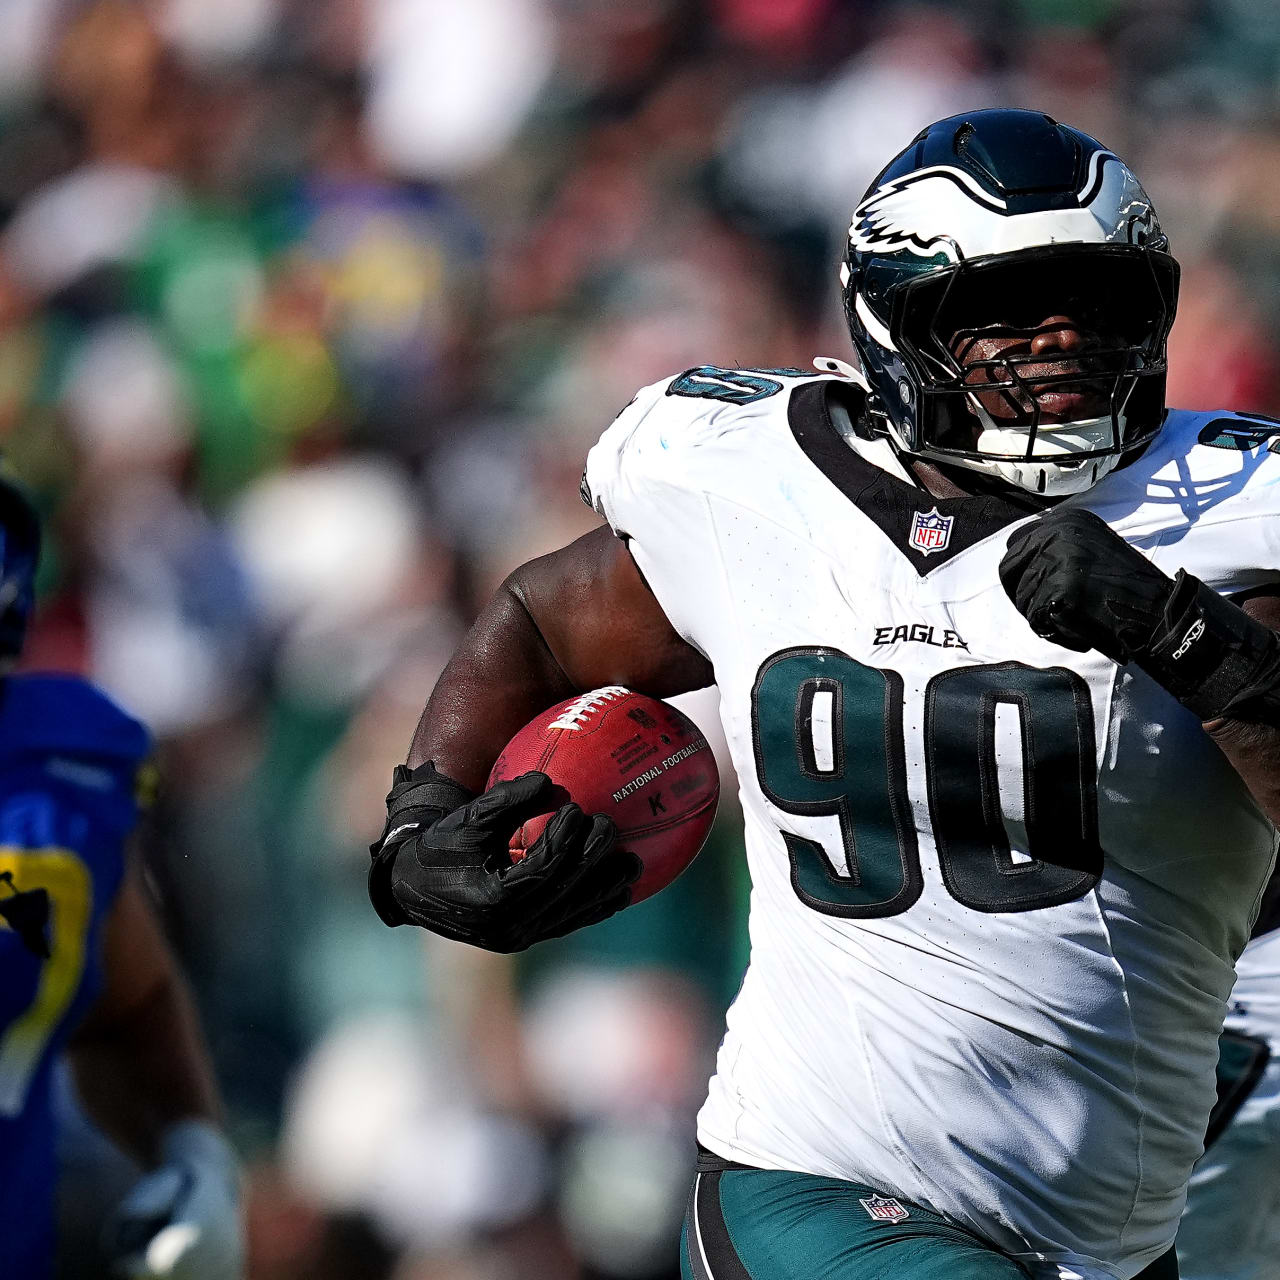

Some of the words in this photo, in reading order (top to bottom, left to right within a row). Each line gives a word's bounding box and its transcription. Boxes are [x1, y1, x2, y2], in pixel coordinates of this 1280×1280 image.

[916, 528, 944, 547] NFL
[612, 766, 663, 803] NATIONAL
[662, 743, 699, 770] FOOTBALL
[751, 645, 1104, 919] 90
[648, 793, 667, 816] K
[873, 1206, 903, 1217] NFL
